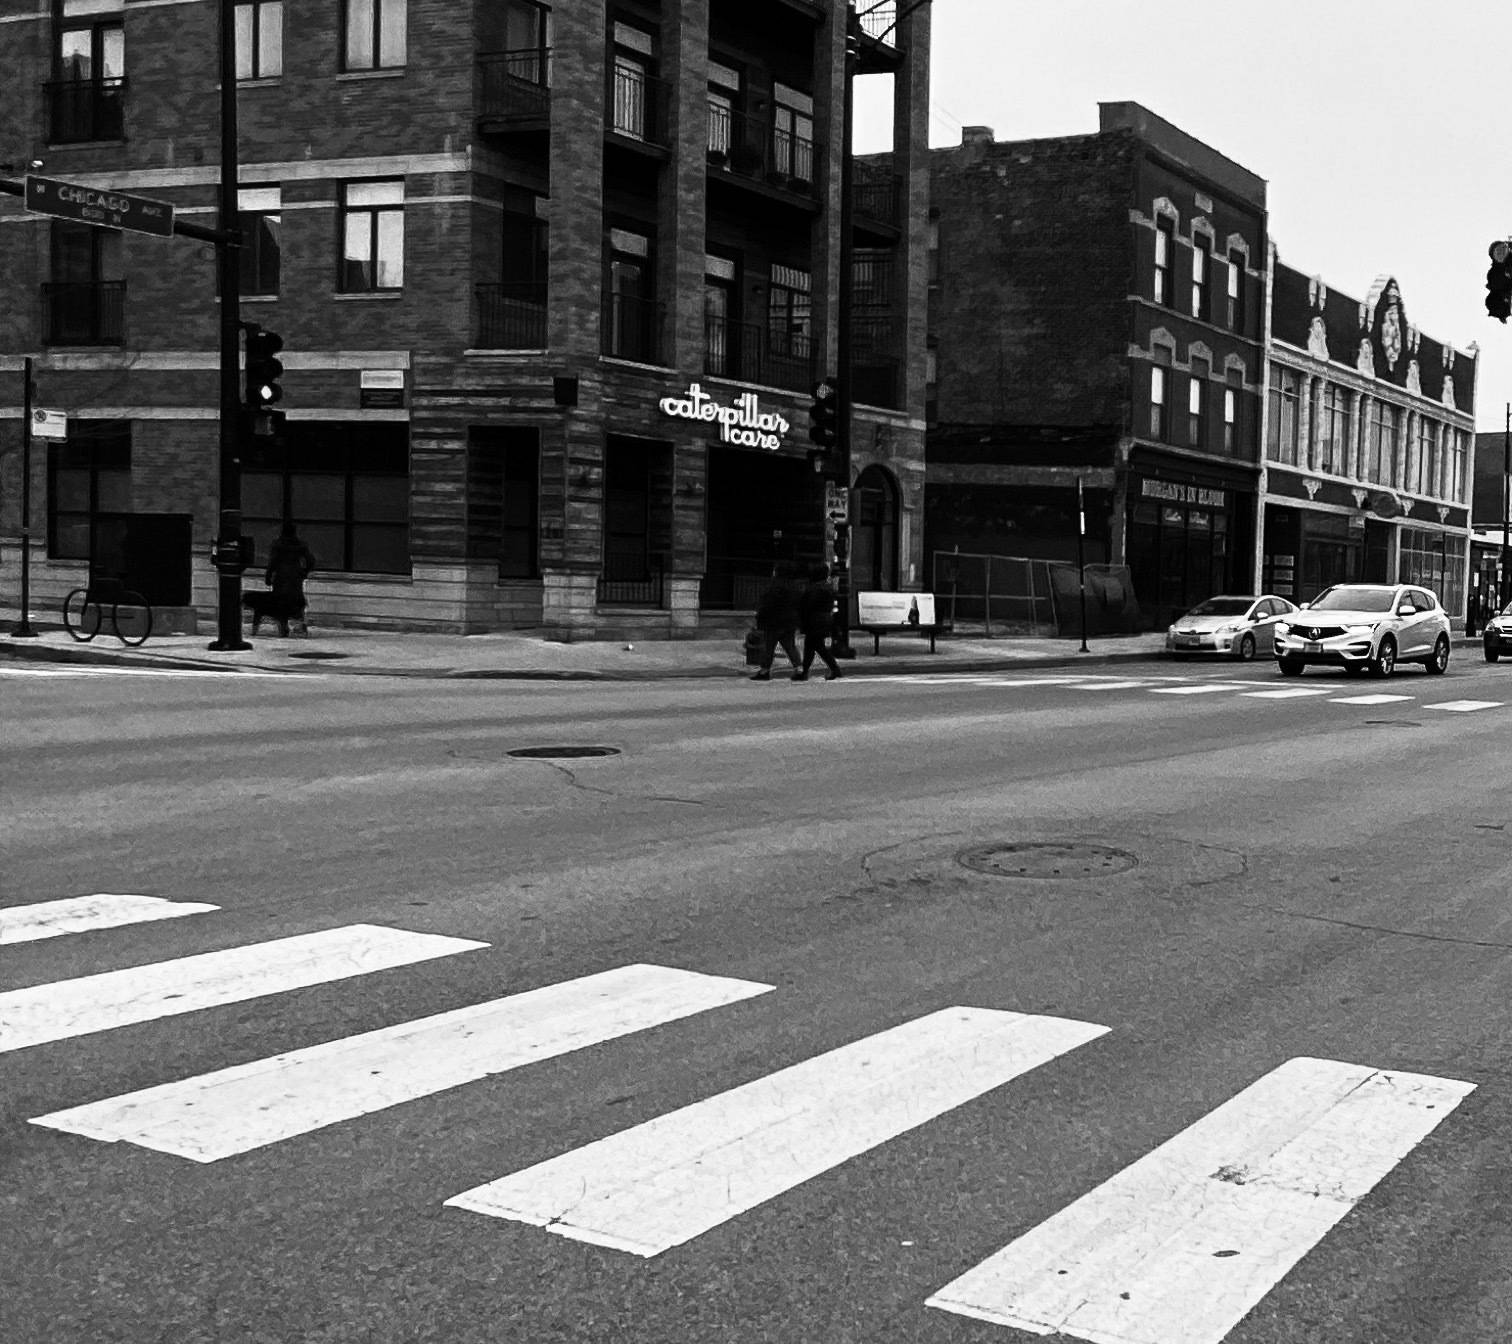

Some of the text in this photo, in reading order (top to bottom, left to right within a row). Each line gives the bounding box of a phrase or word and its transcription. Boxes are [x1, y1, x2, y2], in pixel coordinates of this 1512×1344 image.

[57, 185, 130, 213] CHICAGO
[658, 382, 790, 443] caterpillar
[729, 428, 782, 451] care
